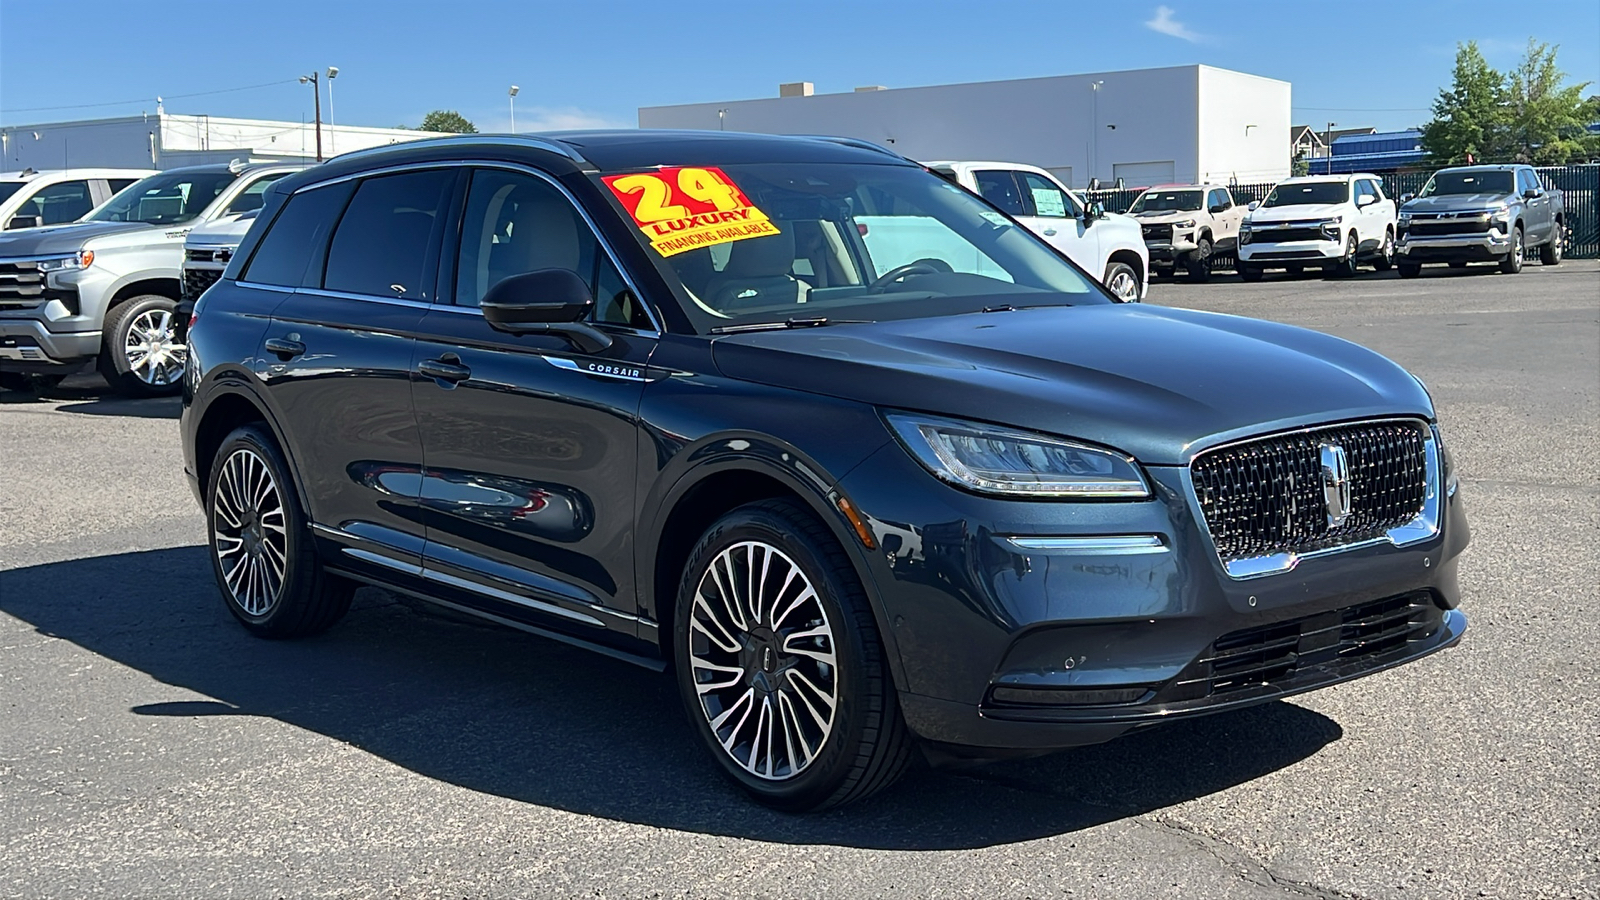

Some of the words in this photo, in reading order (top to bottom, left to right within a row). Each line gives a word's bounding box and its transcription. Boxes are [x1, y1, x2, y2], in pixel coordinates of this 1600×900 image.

[612, 168, 742, 222] 24
[652, 209, 750, 236] LUXURY
[657, 231, 718, 253] FINANCING
[716, 222, 773, 240] AVAILABLE
[588, 363, 640, 377] CORSAIR
